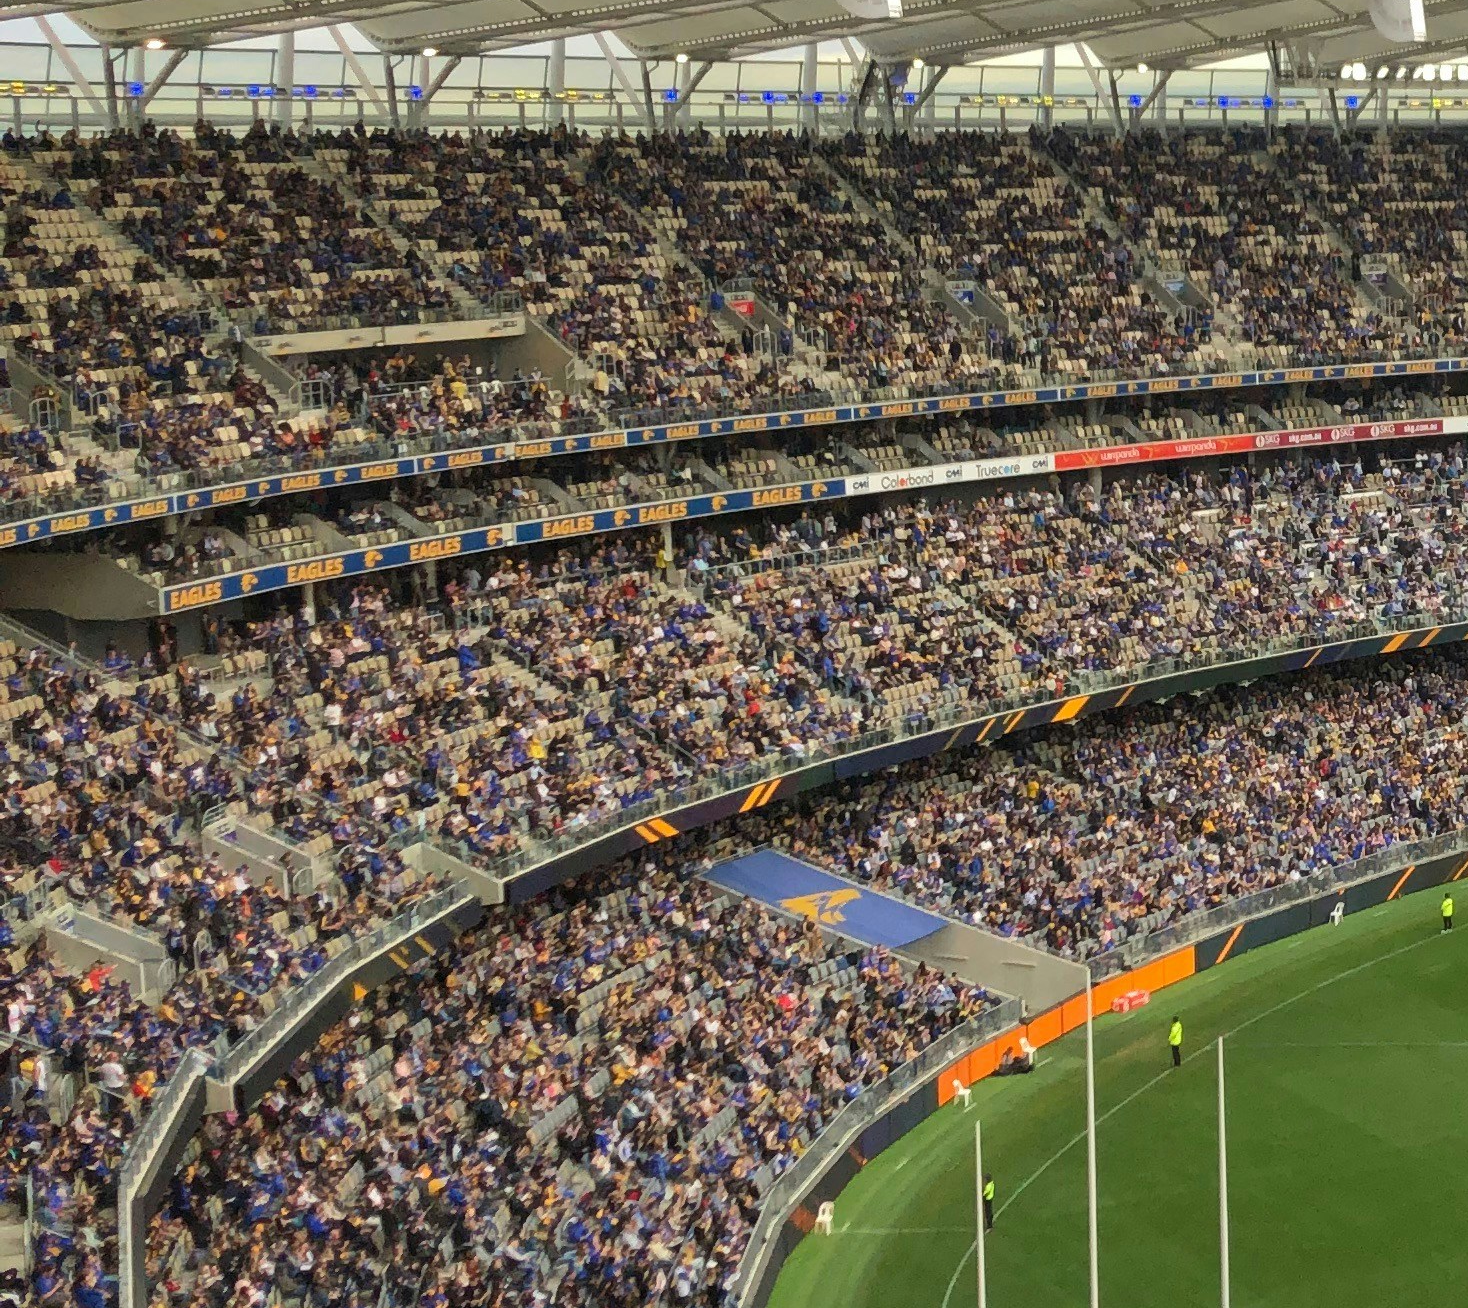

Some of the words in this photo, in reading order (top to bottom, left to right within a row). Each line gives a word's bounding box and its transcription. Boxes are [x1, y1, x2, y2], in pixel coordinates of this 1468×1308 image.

[51, 516, 89, 531] EAGLES
[133, 501, 167, 517] EAGLES
[213, 487, 246, 503] EAGLES
[282, 474, 320, 491] EAGLES
[362, 464, 398, 479] EAGLES
[449, 452, 482, 467] EAGLES
[513, 442, 551, 457] EAGLES
[591, 433, 625, 447] EAGLES
[668, 425, 698, 438] EAGLES
[734, 417, 765, 430] EAGLES
[805, 411, 835, 423] EAGLES
[883, 403, 912, 416] EAGLES
[881, 471, 934, 489] Colorbond
[976, 463, 1020, 477] Truecore
[171, 582, 220, 609] EAGLES
[288, 559, 342, 583] EAGLES
[410, 539, 460, 560] EAGLES
[544, 517, 593, 538] EAGLES
[640, 503, 686, 523] EAGLES
[754, 486, 801, 506] EAGLES
